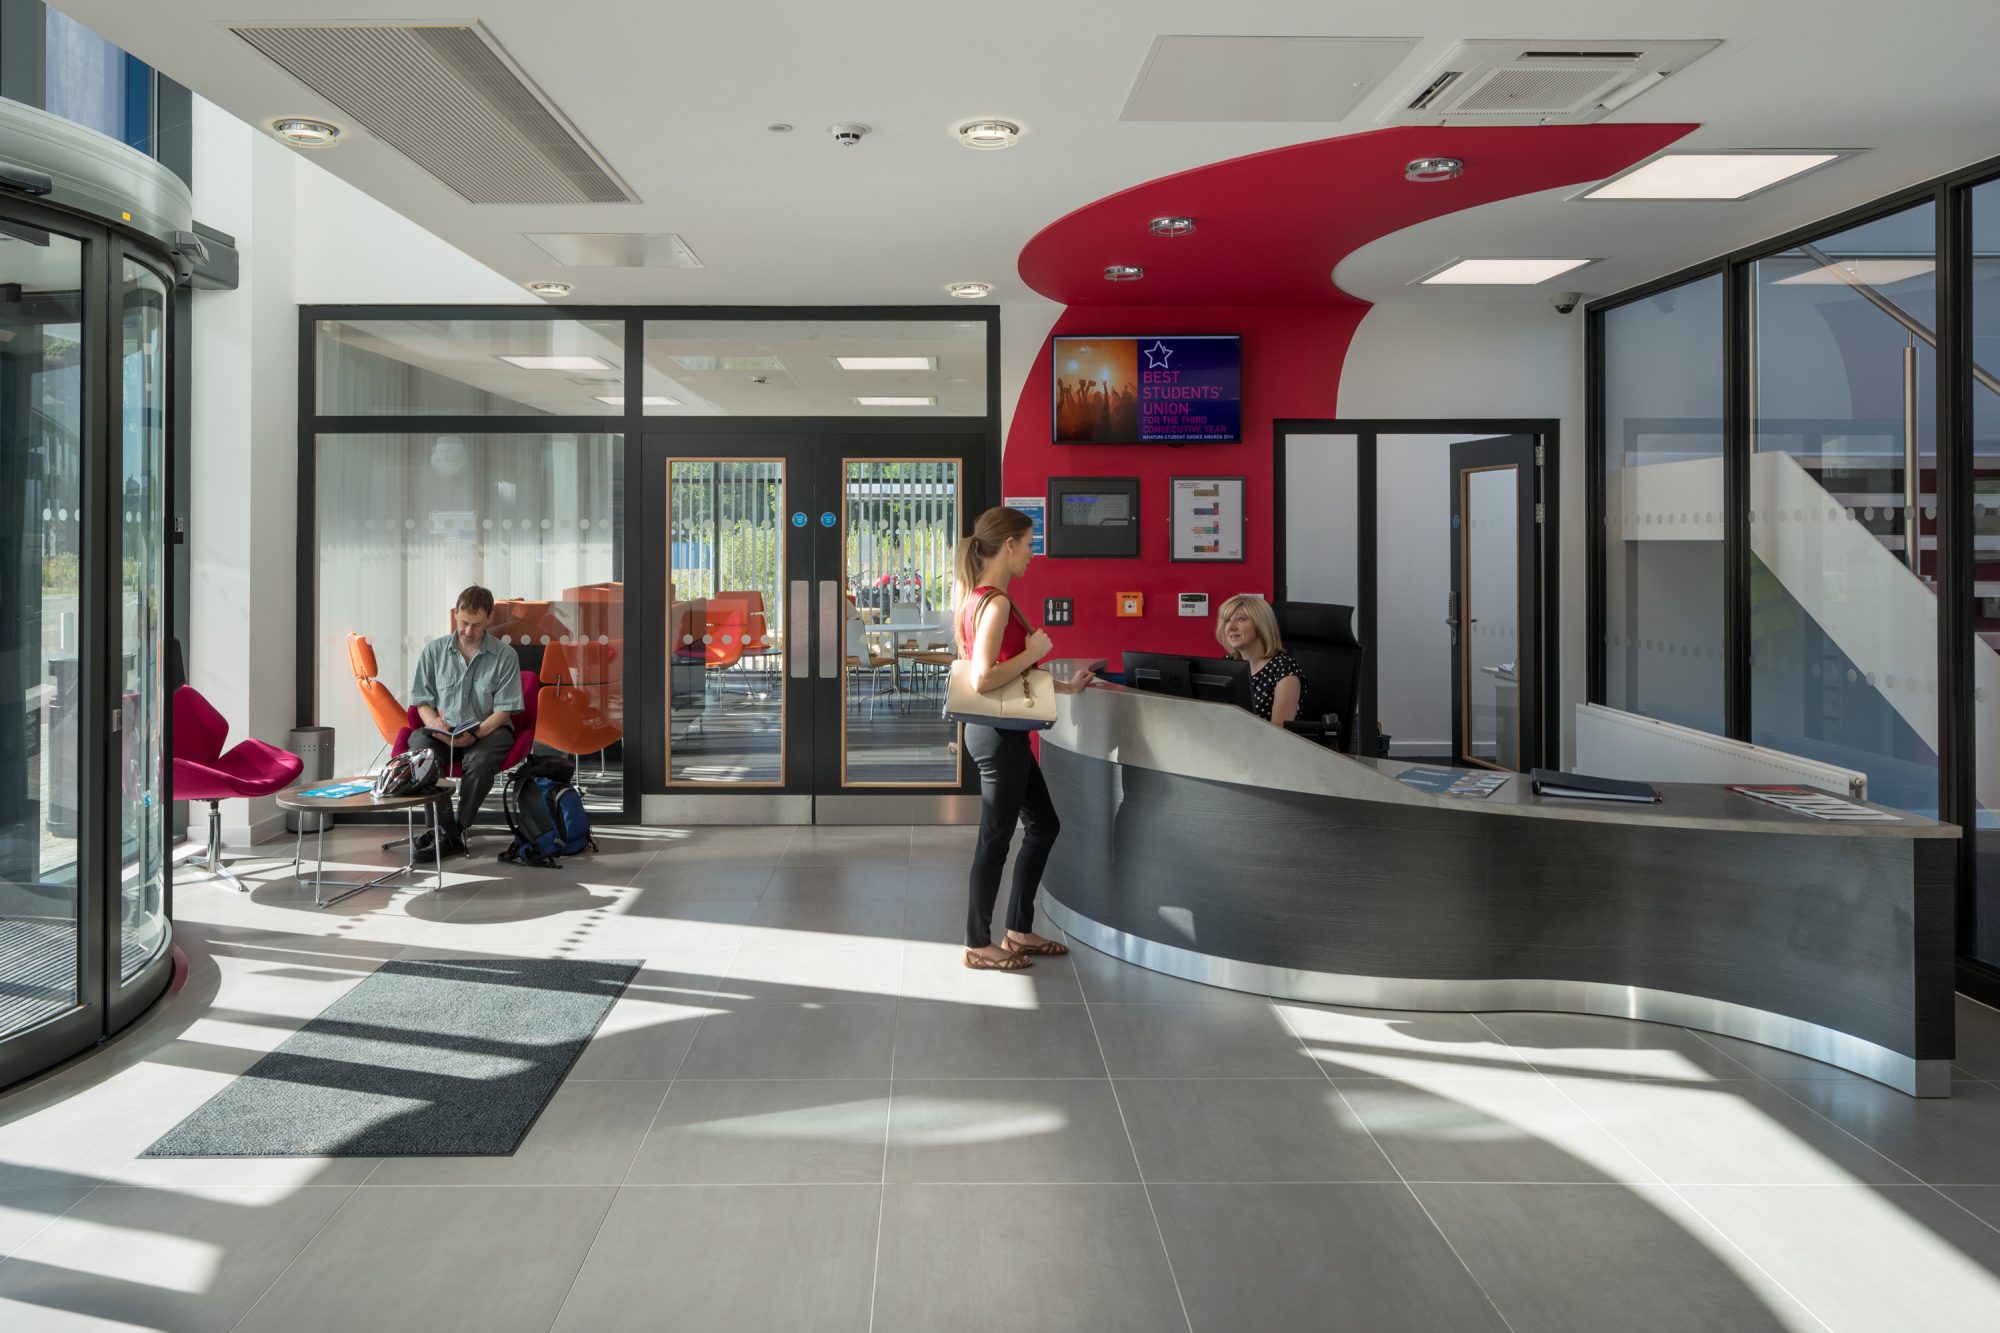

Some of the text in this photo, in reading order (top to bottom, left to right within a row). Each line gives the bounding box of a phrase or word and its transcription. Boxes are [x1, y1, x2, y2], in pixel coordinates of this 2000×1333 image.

[1144, 371, 1180, 384] BEST
[1144, 402, 1189, 415] UNION
[1143, 416, 1207, 424] FOR THE THIRD
[1143, 425, 1227, 433] CONSECUTIVE YEAR
